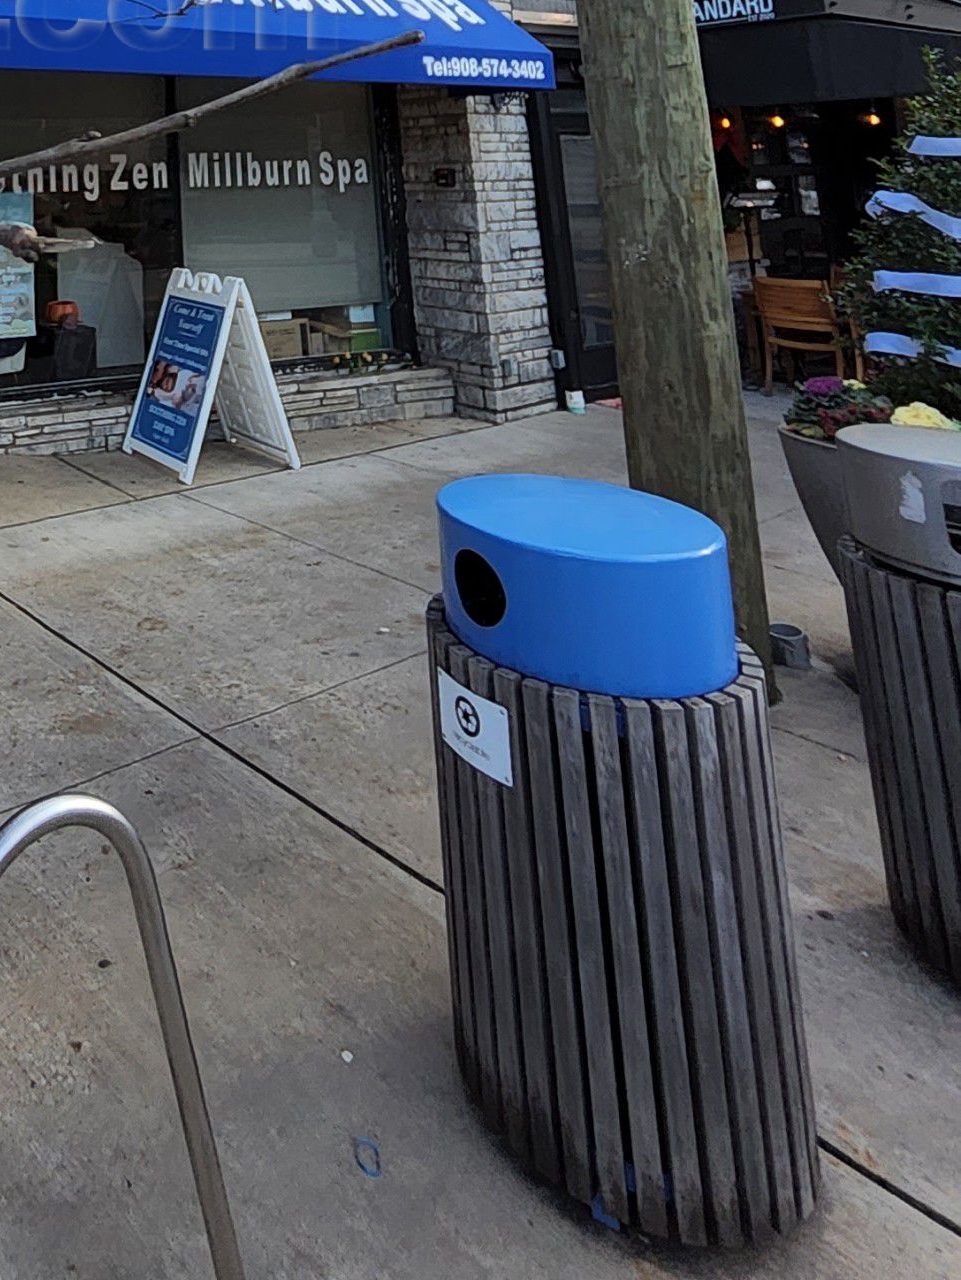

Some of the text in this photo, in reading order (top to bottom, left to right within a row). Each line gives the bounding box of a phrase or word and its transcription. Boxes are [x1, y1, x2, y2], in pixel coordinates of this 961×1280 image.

[422, 55, 546, 80] Tel:908-574-3402
[109, 153, 169, 192] Zen
[188, 151, 311, 188] Millburn
[318, 151, 369, 193] Spa
